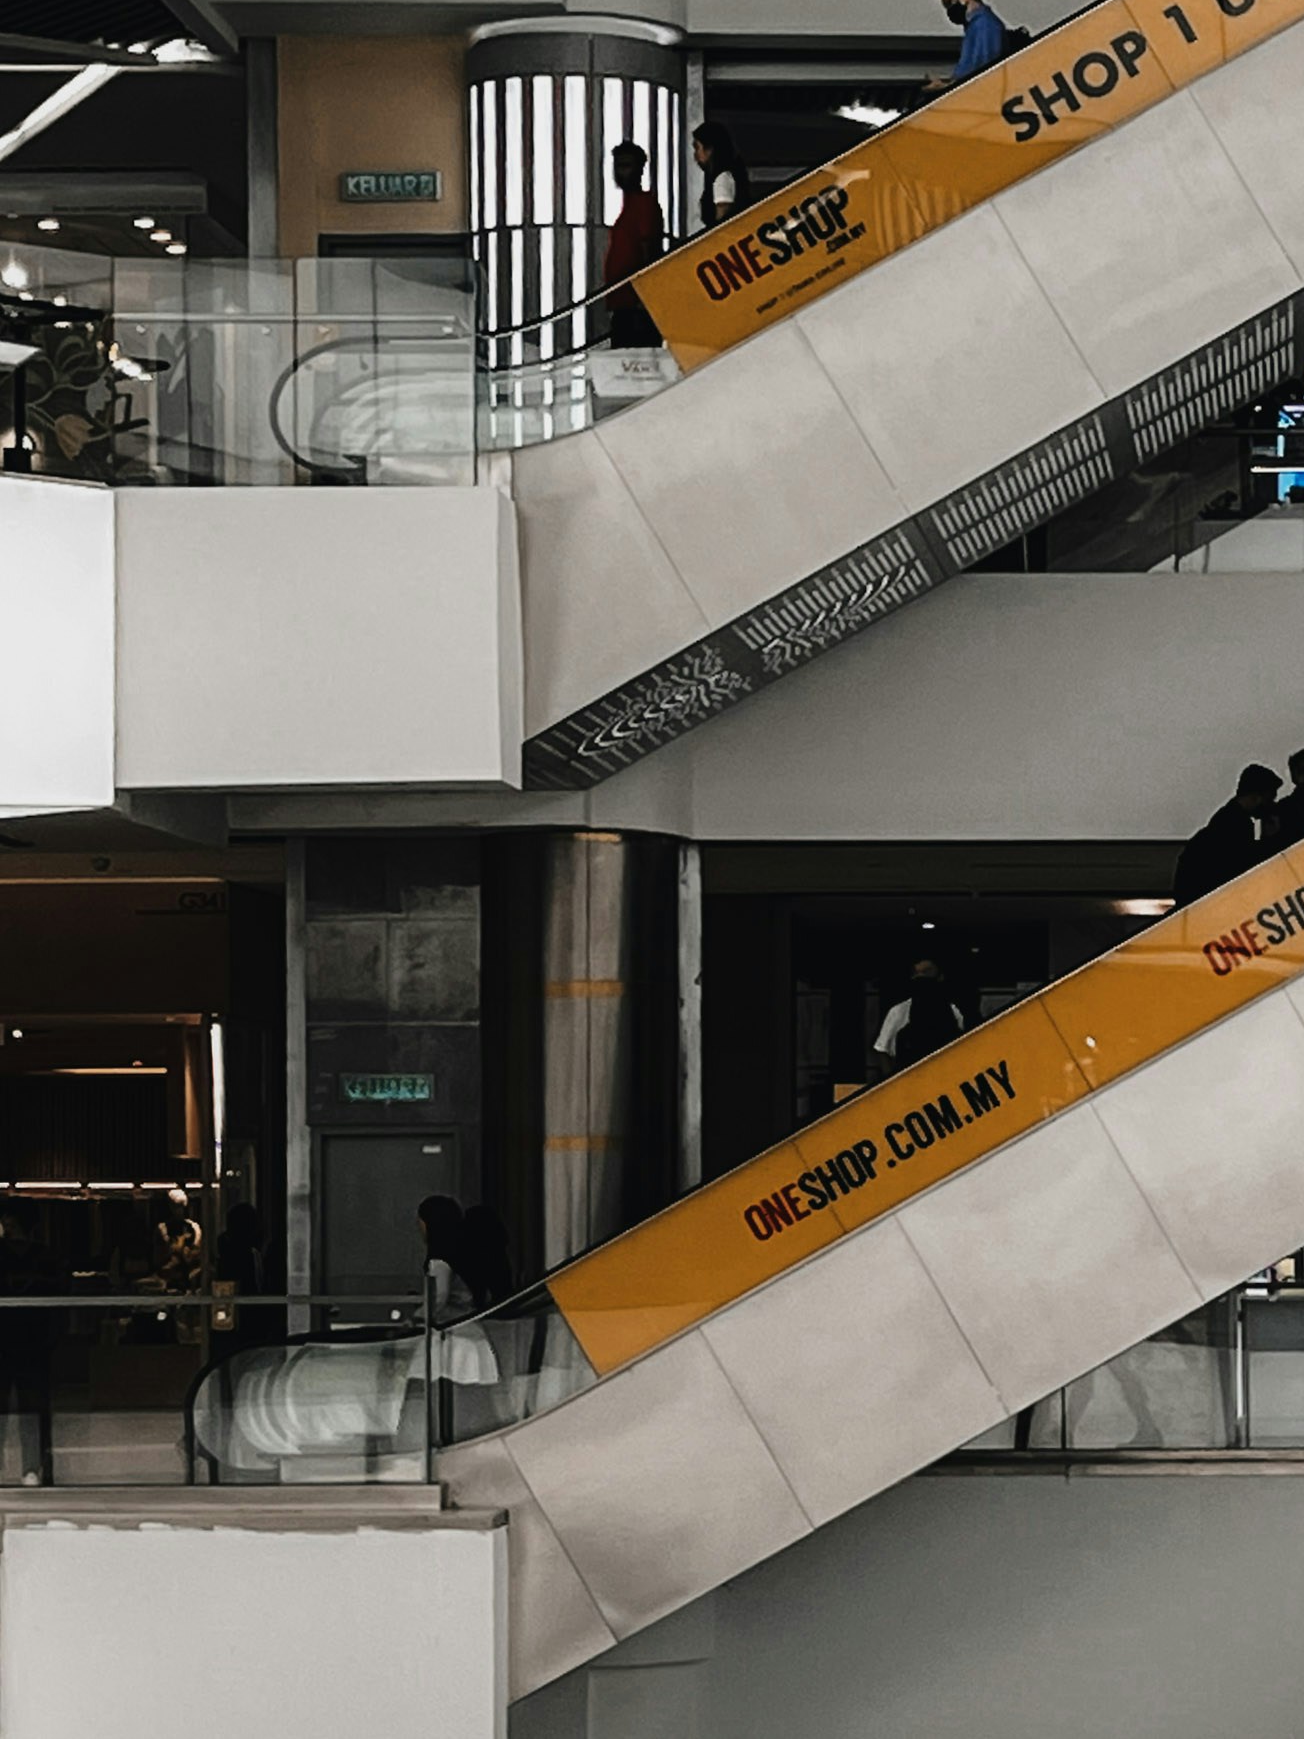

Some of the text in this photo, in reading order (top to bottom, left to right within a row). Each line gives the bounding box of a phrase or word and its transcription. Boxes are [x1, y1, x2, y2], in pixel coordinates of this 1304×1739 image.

[1001, 30, 1147, 143] SHOP
[1163, 4, 1198, 44] 1
[697, 185, 849, 300] ONESHOP
[743, 1059, 1017, 1242] ONESHOP.COM.MY
